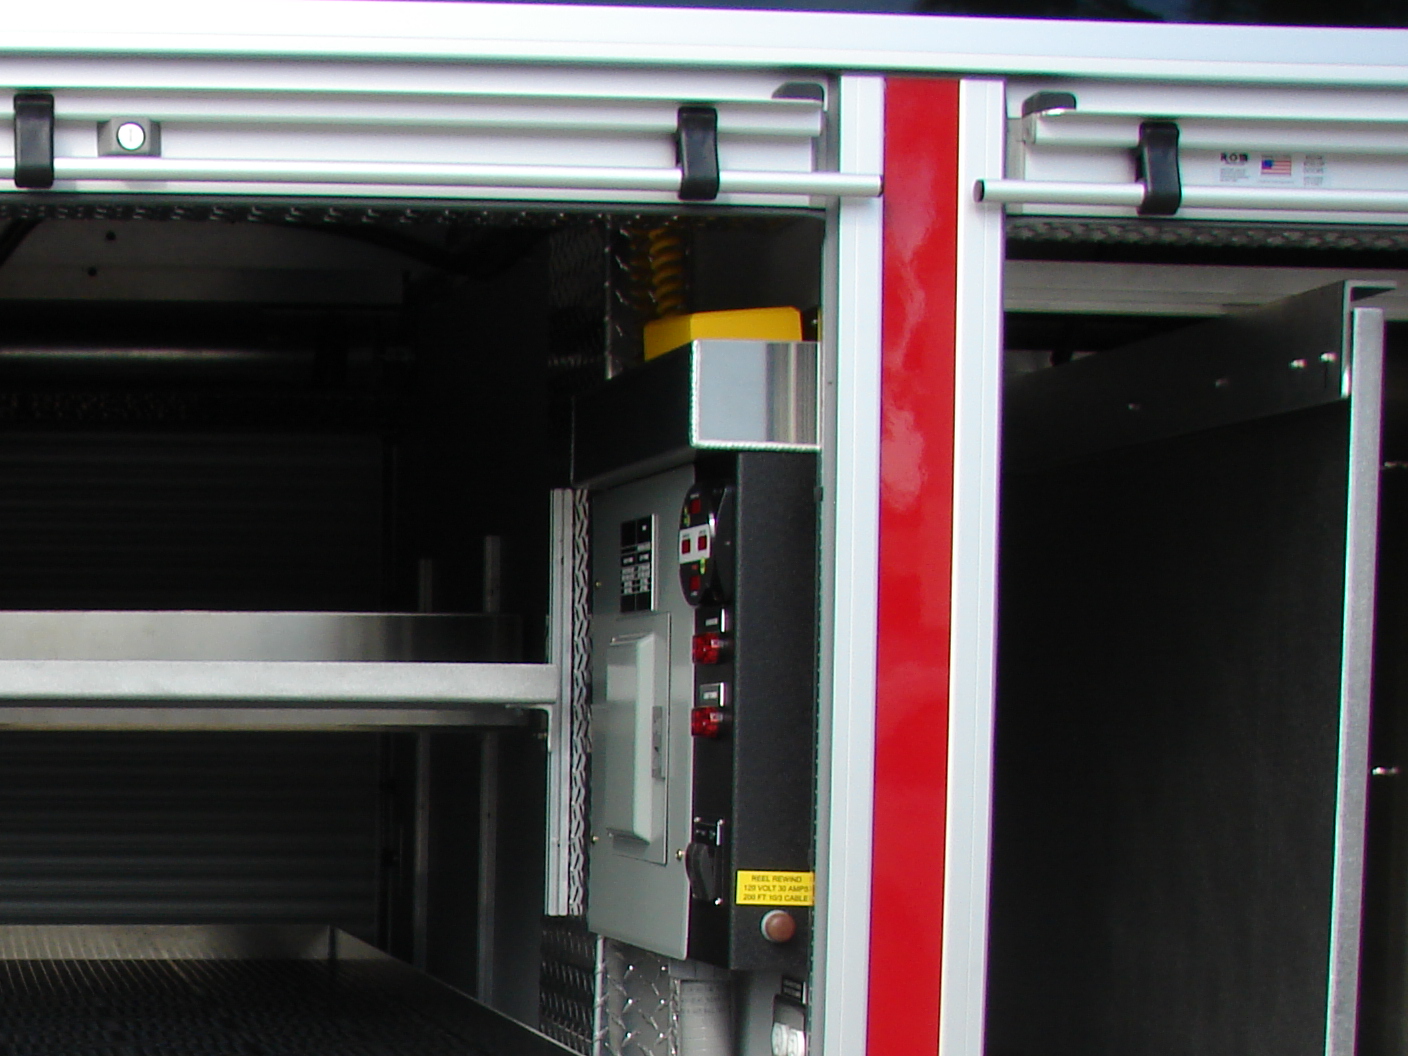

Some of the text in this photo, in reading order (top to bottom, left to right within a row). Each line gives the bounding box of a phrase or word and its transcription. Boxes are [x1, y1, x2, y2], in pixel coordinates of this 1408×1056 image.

[751, 874, 802, 883] REEL REWIND
[758, 884, 776, 892] VOLT
[788, 885, 809, 893] AMPS
[757, 893, 767, 901] FT
[784, 894, 808, 902] CABLE
